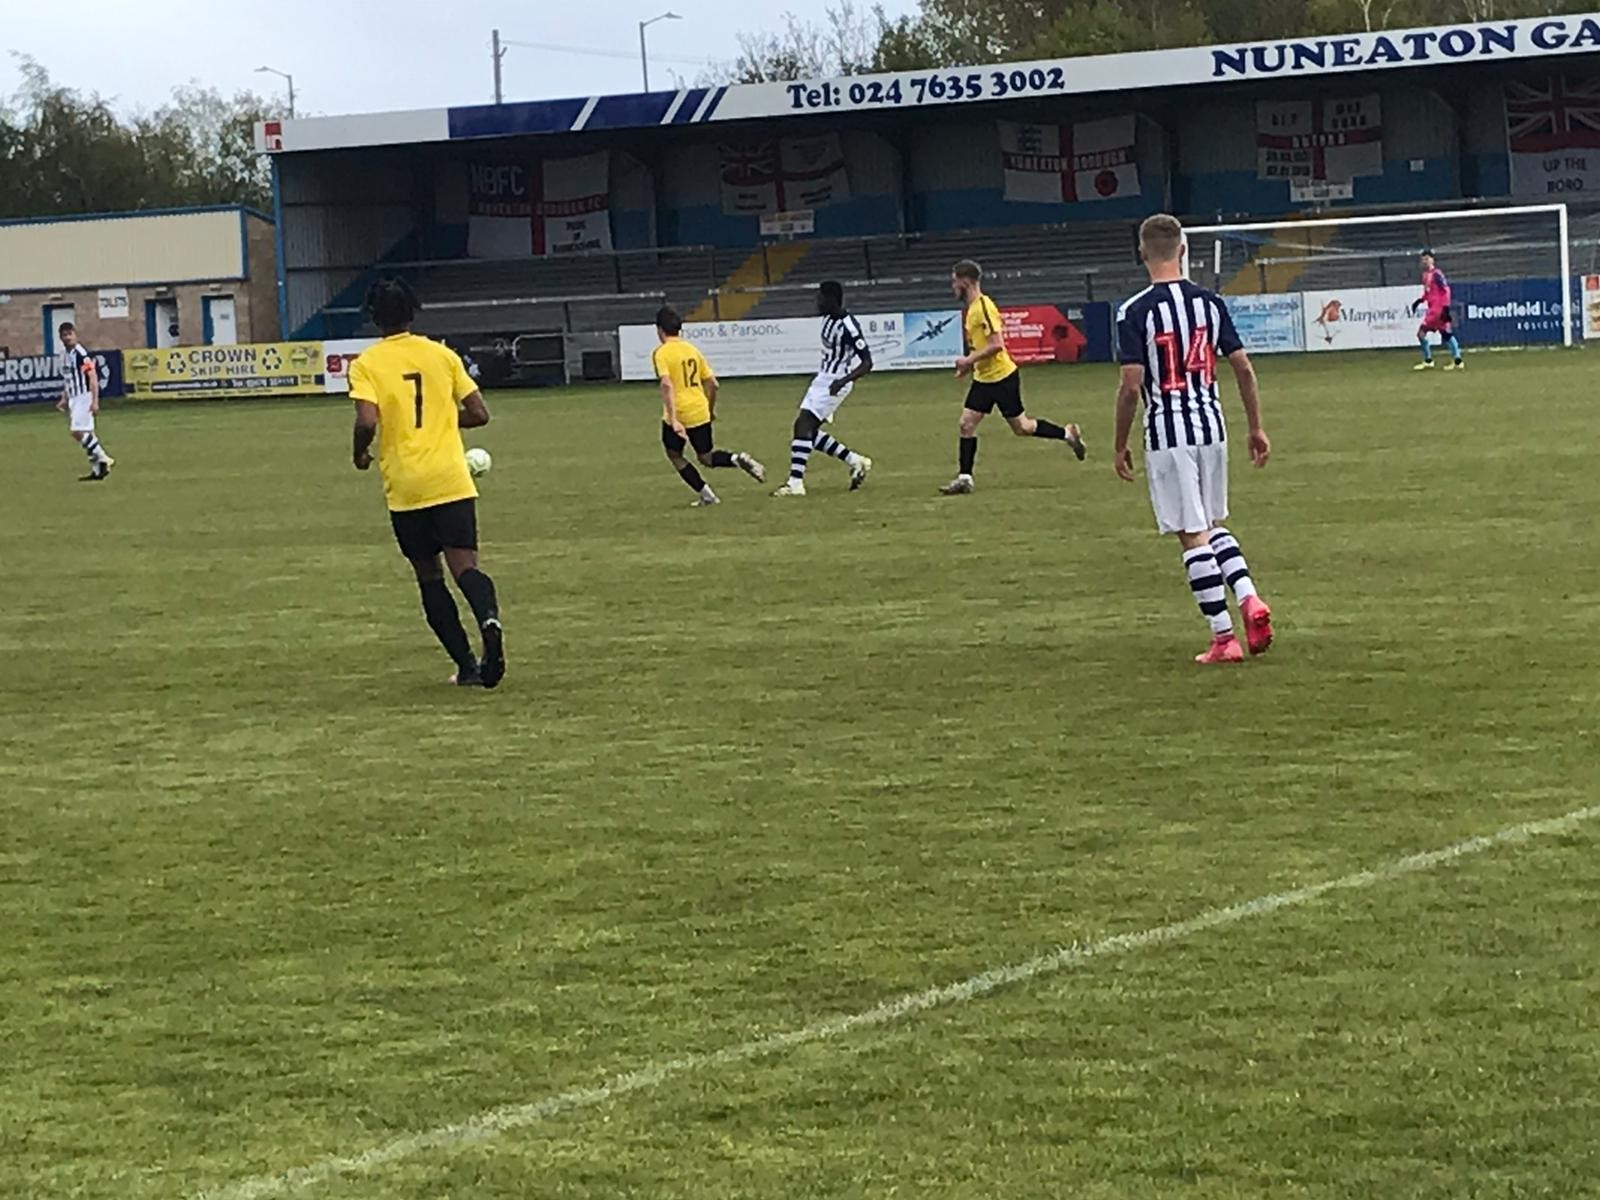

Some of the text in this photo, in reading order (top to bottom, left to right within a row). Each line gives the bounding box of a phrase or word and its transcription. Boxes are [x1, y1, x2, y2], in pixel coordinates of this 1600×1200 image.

[1212, 25, 1518, 76] NUNEATON
[787, 67, 1065, 108] Tel: 024 7635 3002
[1543, 157, 1588, 173] UP THE
[471, 164, 526, 196] NBFC
[1547, 178, 1584, 193] BORO
[1340, 306, 1398, 325] Marjorie
[1468, 301, 1541, 319] Bromfield
[680, 326, 714, 339] rsons
[717, 323, 730, 338] &
[188, 349, 257, 365] CROWN
[1155, 326, 1216, 392] 14
[190, 364, 257, 378] SKIP HIRE
[681, 358, 698, 388] 12
[402, 372, 422, 428] 7
